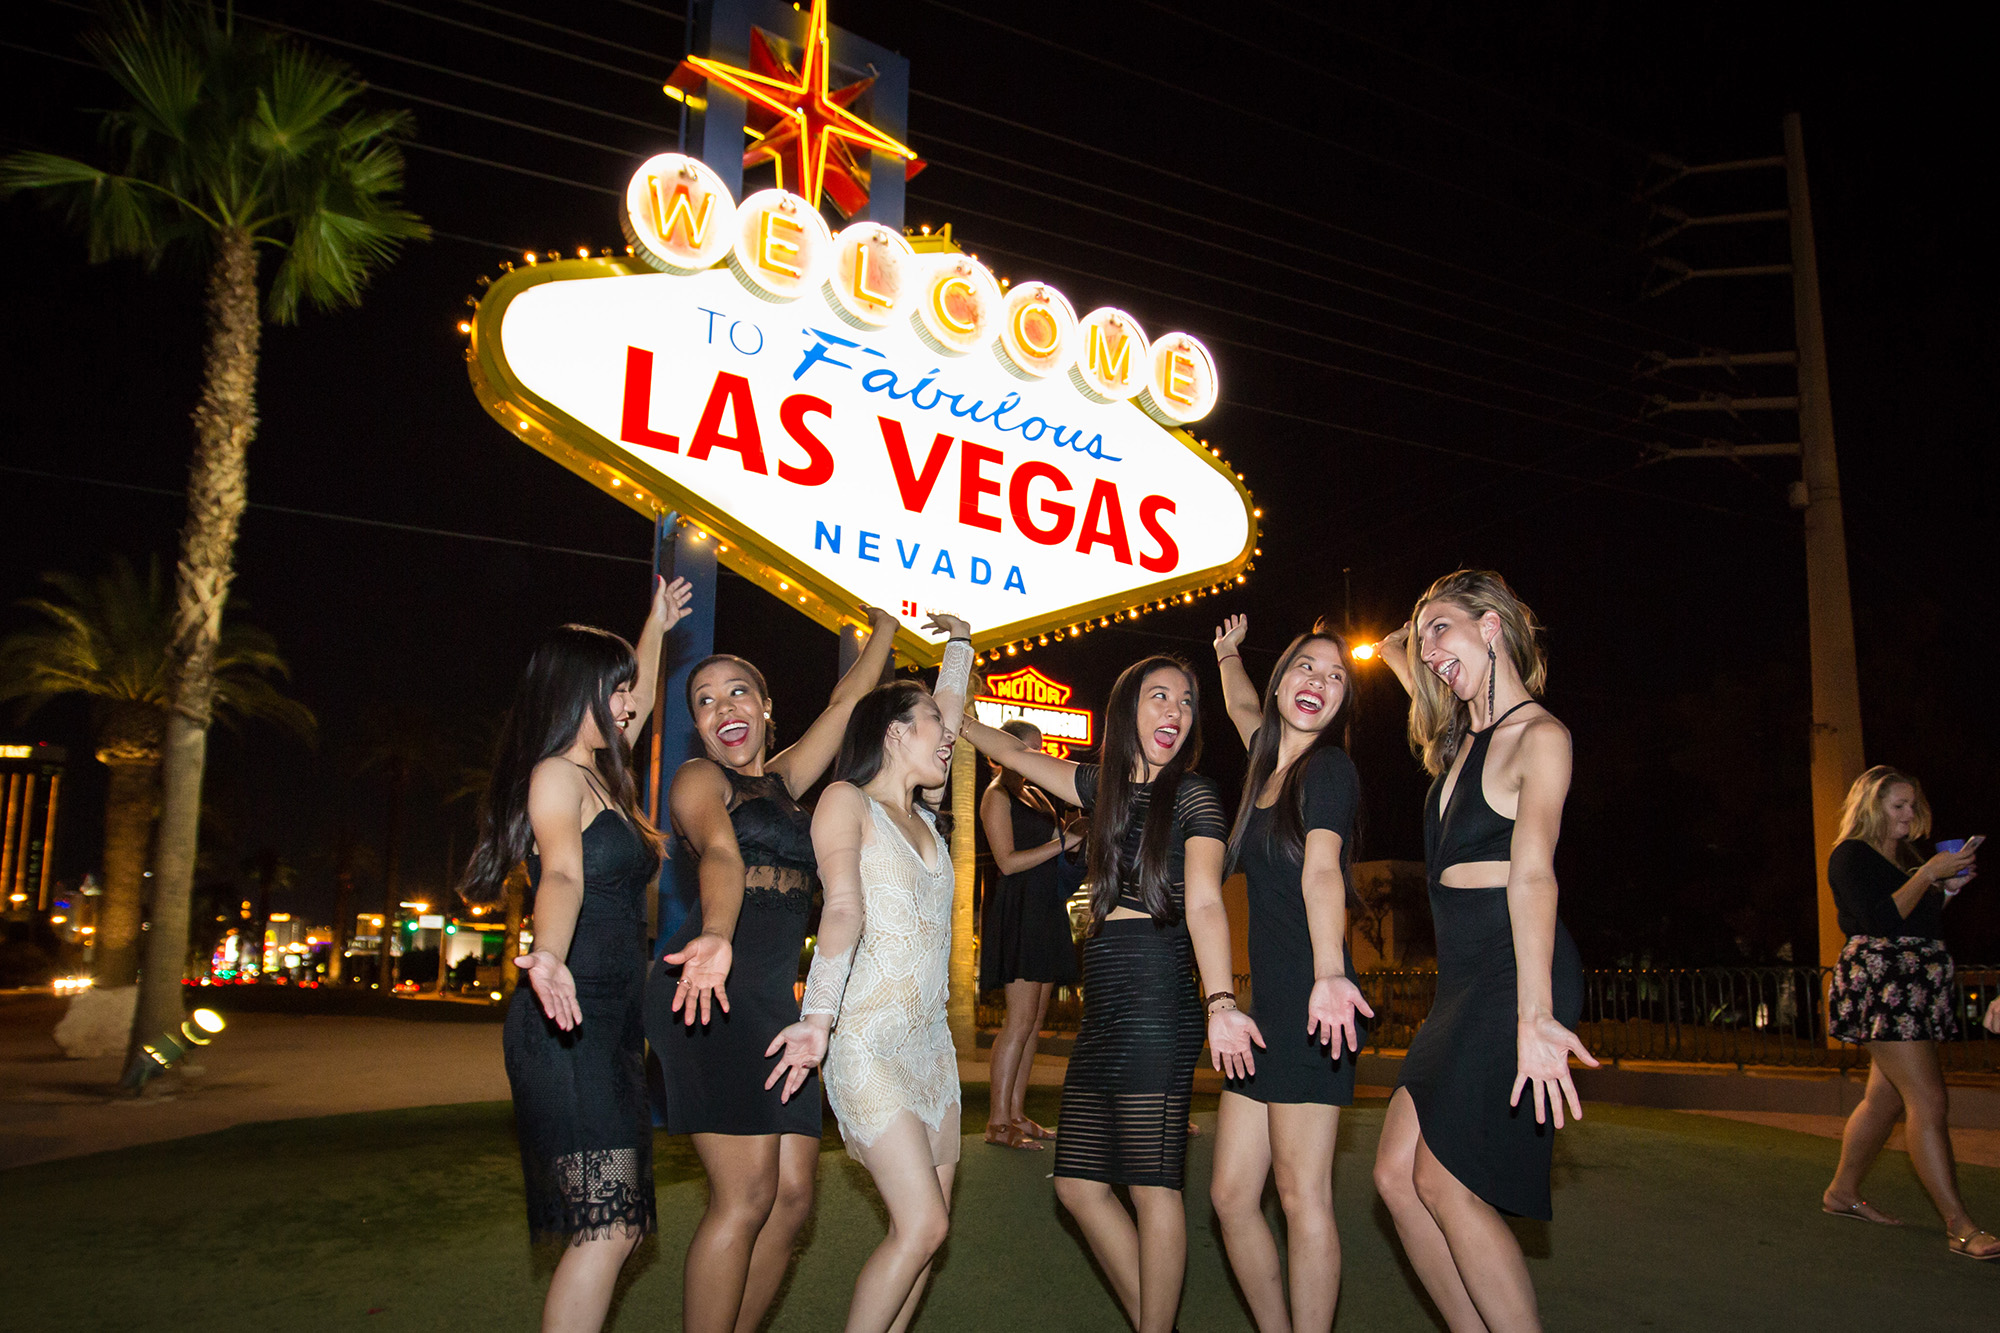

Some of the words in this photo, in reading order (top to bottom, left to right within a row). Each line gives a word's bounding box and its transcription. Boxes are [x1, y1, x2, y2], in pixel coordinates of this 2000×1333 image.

[648, 175, 1194, 407] WELCOME
[620, 345, 836, 487] LAS
[877, 415, 1180, 575] VEGAS
[697, 307, 764, 356] TO
[792, 327, 1124, 463] Fabulous
[814, 520, 1027, 595] NEVADA
[997, 673, 1061, 706] MOTOR
